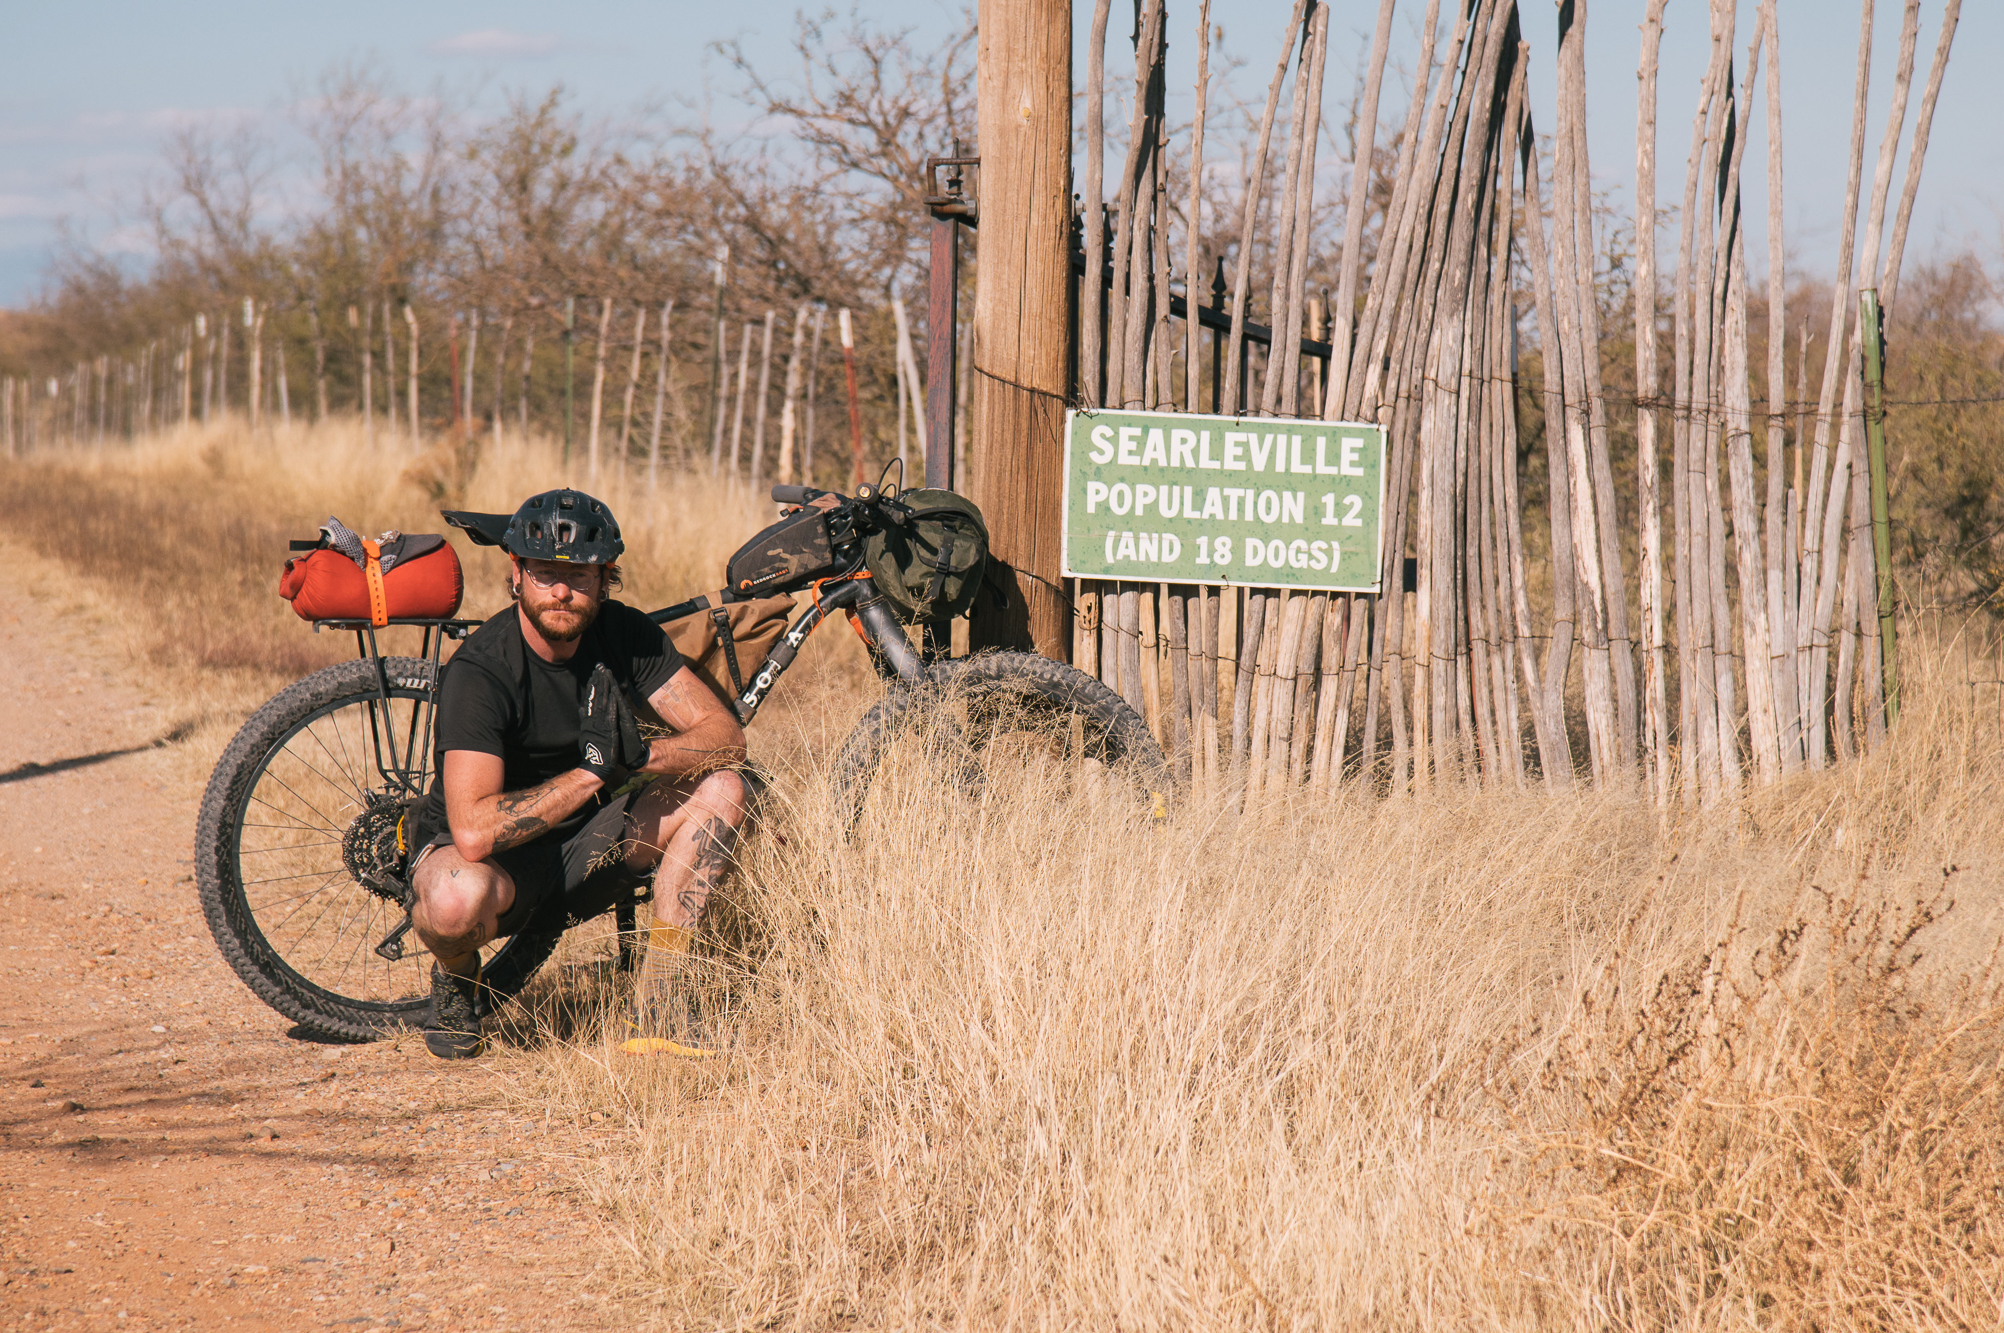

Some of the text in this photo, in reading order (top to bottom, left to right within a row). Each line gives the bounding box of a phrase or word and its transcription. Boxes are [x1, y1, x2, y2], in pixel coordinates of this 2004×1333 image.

[1088, 424, 1365, 477] SEARLEVILLE
[1086, 480, 1363, 527] POPULATION 12
[1104, 530, 1341, 574] (AND 18 DOGS)
